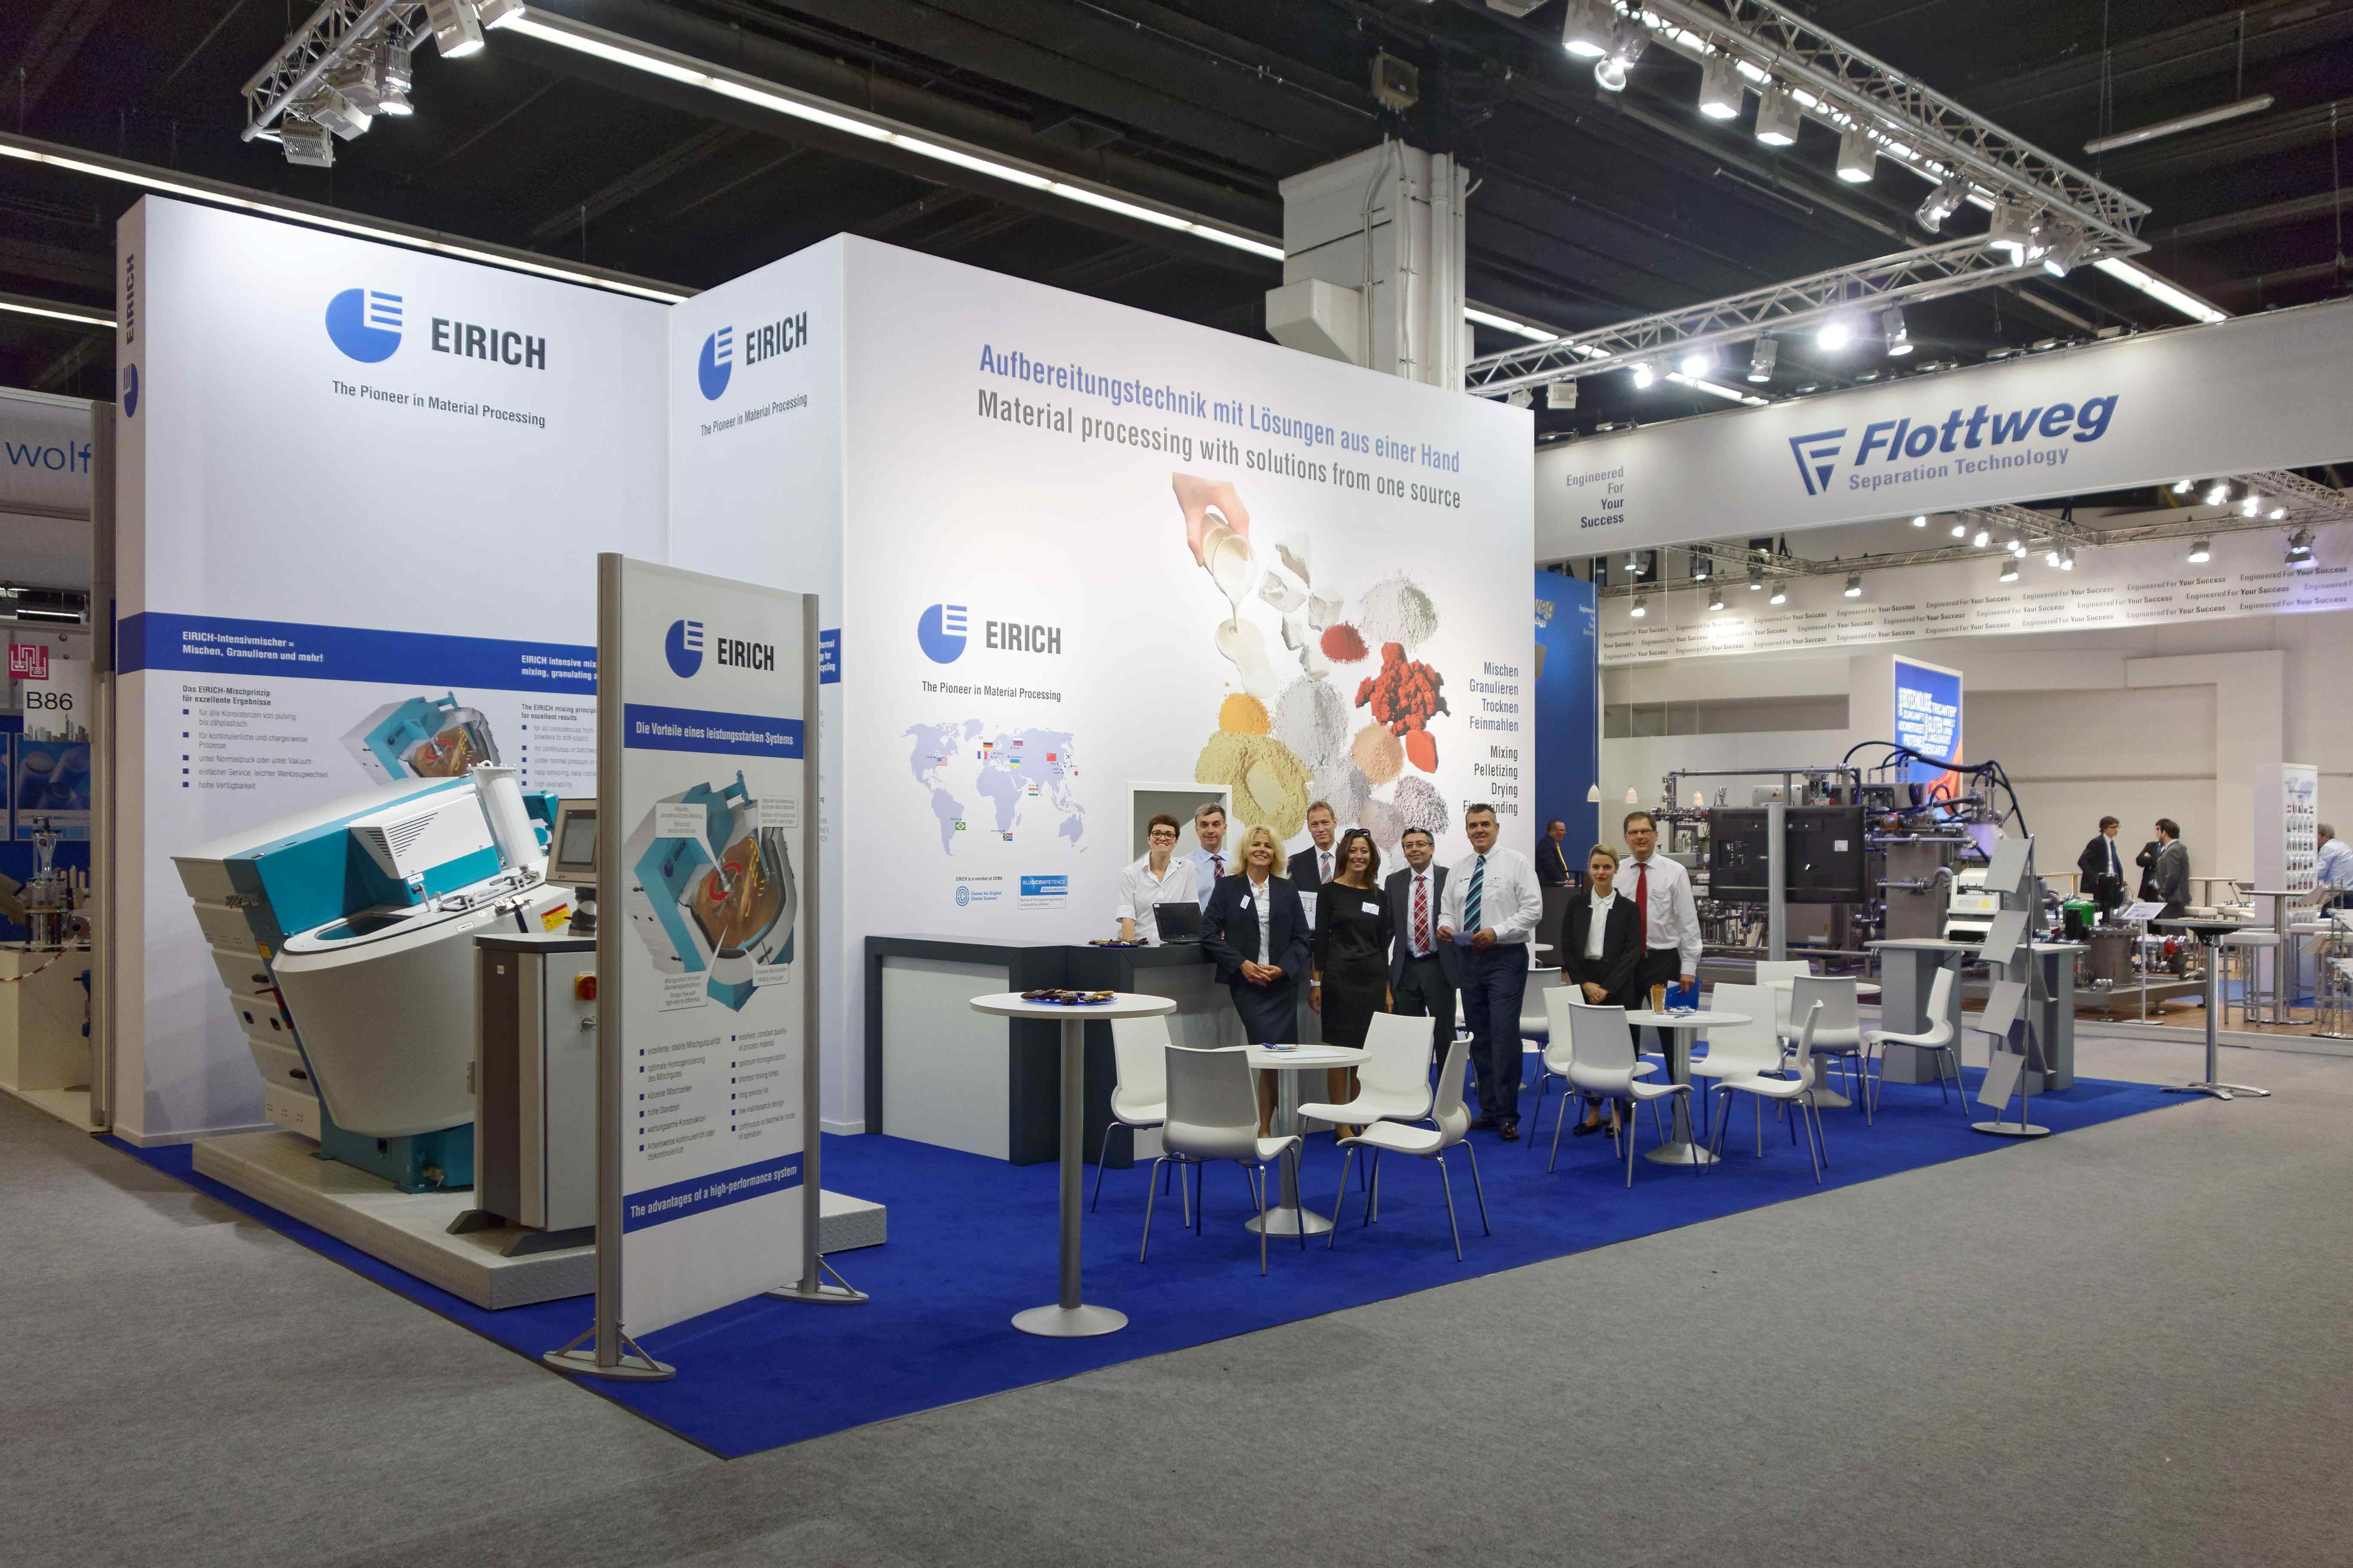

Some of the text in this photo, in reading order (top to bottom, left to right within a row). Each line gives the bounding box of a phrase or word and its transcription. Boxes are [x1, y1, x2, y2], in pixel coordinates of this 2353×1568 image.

[431, 317, 545, 370] EIRICH
[746, 310, 807, 366] EIRICH
[332, 380, 545, 428] The Pioneer in Material Processing
[979, 343, 1459, 472] Aufbereitungstechnik mit Lösungen aus einer Hand
[701, 394, 807, 436] The Pioneer in Material Processing
[1854, 393, 2121, 466] Flottweg
[978, 388, 1460, 509] Material processing with solutions from one source
[1566, 466, 1624, 487] Engineered
[1849, 447, 2070, 491] Separation Technology
[1608, 482, 1624, 494] For
[1601, 498, 1624, 510] Your
[1581, 513, 1624, 528] Success
[2127, 582, 2165, 591] Engineered
[2197, 576, 2226, 585] Success
[2240, 571, 2282, 581] Engineered
[2023, 591, 2058, 600] Engineered
[2186, 590, 2226, 600] Engineered
[1837, 608, 1868, 616] Engineered
[1926, 600, 1959, 609] Engineered
[1755, 615, 1782, 624] Engineered
[183, 631, 287, 647] EIRICH-Intensivmischer
[986, 620, 1061, 654] EIRICH
[183, 644, 323, 662] Mischen, Granulieren und mehr!
[522, 655, 547, 665] EIRICH
[549, 657, 582, 667] intensive
[718, 637, 774, 671] EIRICH
[522, 667, 592, 680] mixing, granulating
[1484, 661, 1519, 678] Mischen
[199, 686, 270, 697] EIRICH-Mischprinzip
[922, 680, 1061, 702] The Pioneer in Material Processing
[1469, 679, 1519, 695] Granulieren
[26, 691, 73, 711] B86
[194, 696, 230, 704] exzellente
[233, 698, 271, 706] Ergebnisse
[1482, 698, 1519, 714] Trocknen
[555, 705, 574, 714] mixing
[1469, 716, 1519, 732] Feinmahlen
[636, 721, 793, 746] Die Vorteile eines leistungsstarken Systems
[1491, 745, 1518, 762] Mixing
[1474, 763, 1518, 780] Pelletizing
[1491, 782, 1518, 798] Drying
[630, 1165, 797, 1218] The advantages of a high-performance system
